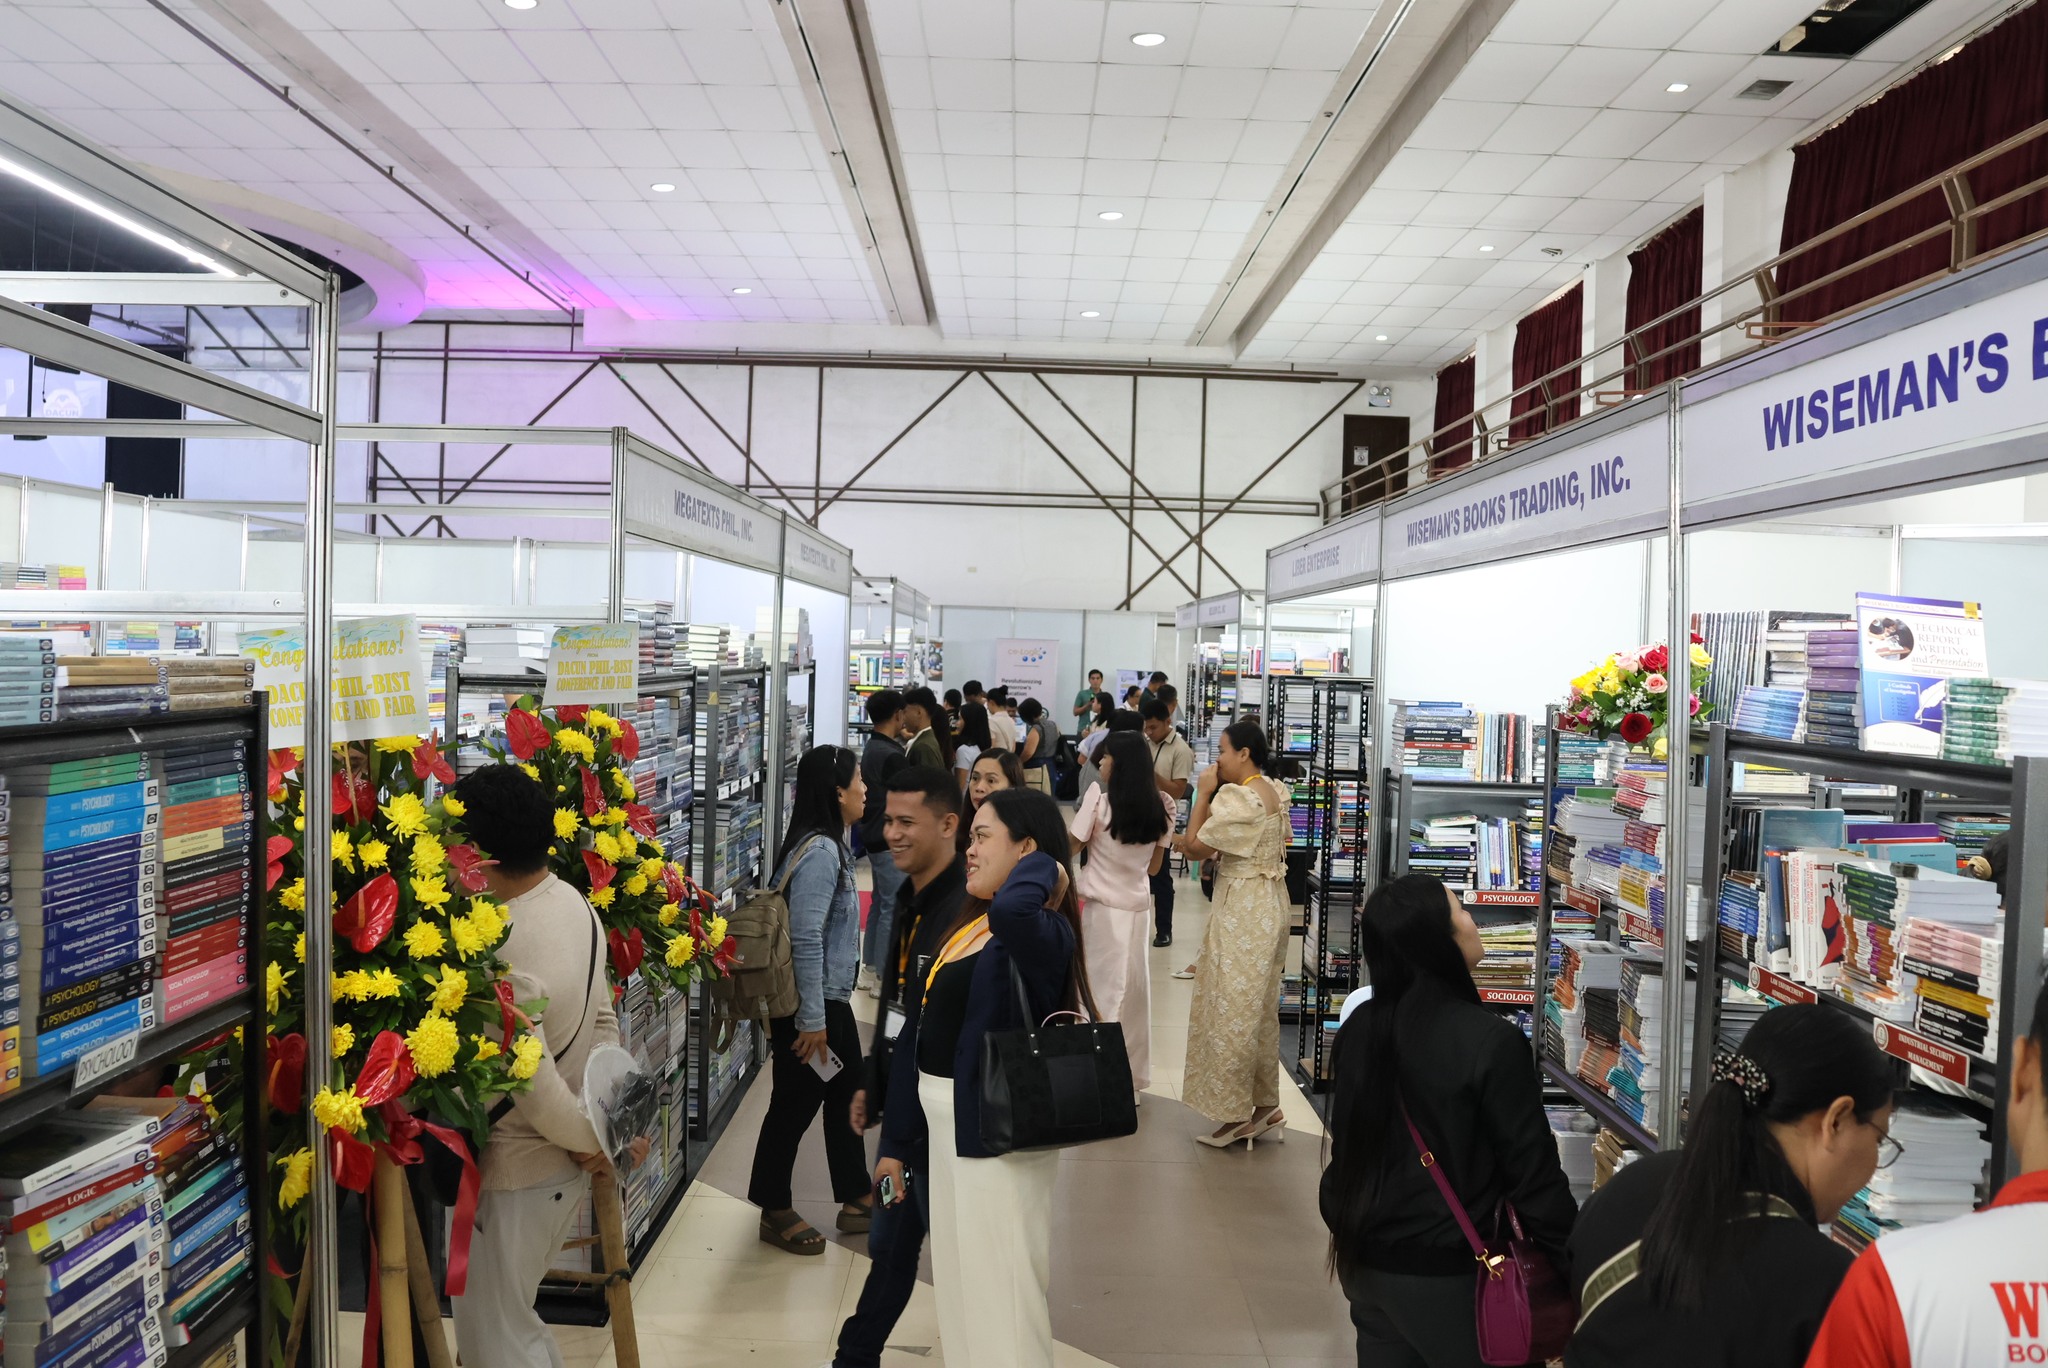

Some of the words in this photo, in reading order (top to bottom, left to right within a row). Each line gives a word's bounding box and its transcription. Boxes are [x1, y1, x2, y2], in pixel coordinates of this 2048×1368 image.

[1763, 332, 2009, 451] WISEMAN'S
[45, 408, 80, 418] DACUN
[674, 489, 721, 530] MEGATEXTS
[1406, 508, 1460, 547] WISEMAN'S
[1463, 494, 1506, 534] BOOKS
[1509, 471, 1585, 521] TRADING,
[1591, 456, 1631, 500] INC.
[1916, 622, 1980, 637] TECHNICAL
[1918, 633, 1962, 645] REPORT
[1918, 643, 1970, 656] WRITING
[557, 661, 586, 675] DACUN
[589, 659, 633, 675] PHIL-BIST
[1911, 655, 1928, 664] and
[1929, 654, 1984, 669] Presentation
[556, 676, 599, 691] CONFERENCE
[600, 675, 615, 689] AND
[616, 675, 633, 689] FAIR
[355, 698, 381, 720] AND
[384, 695, 417, 717] FAIR
[1482, 894, 1535, 903] PSYCHOLOGY
[183, 969, 209, 983] PSYCHOLOGY
[51, 978, 101, 1004] PSYCHOLOGY
[183, 991, 209, 1006] PSYCHOLOGY
[1486, 991, 1535, 1002] SOCIOLOGY
[1778, 980, 1804, 998] ENFORCEMENT
[48, 1000, 97, 1026] PSYCHOLOGY
[60, 1018, 104, 1040] PSYCHOLOGY
[61, 1035, 105, 1060] PSYCHOLOGY
[1898, 1034, 1929, 1056] INDUSTRIAL
[1929, 1045, 1955, 1064] SECURITY
[79, 1036, 137, 1081] PSYCHOLOGY
[1907, 1051, 1944, 1074] MANAGEMENT
[67, 1186, 97, 1206] LOGIC
